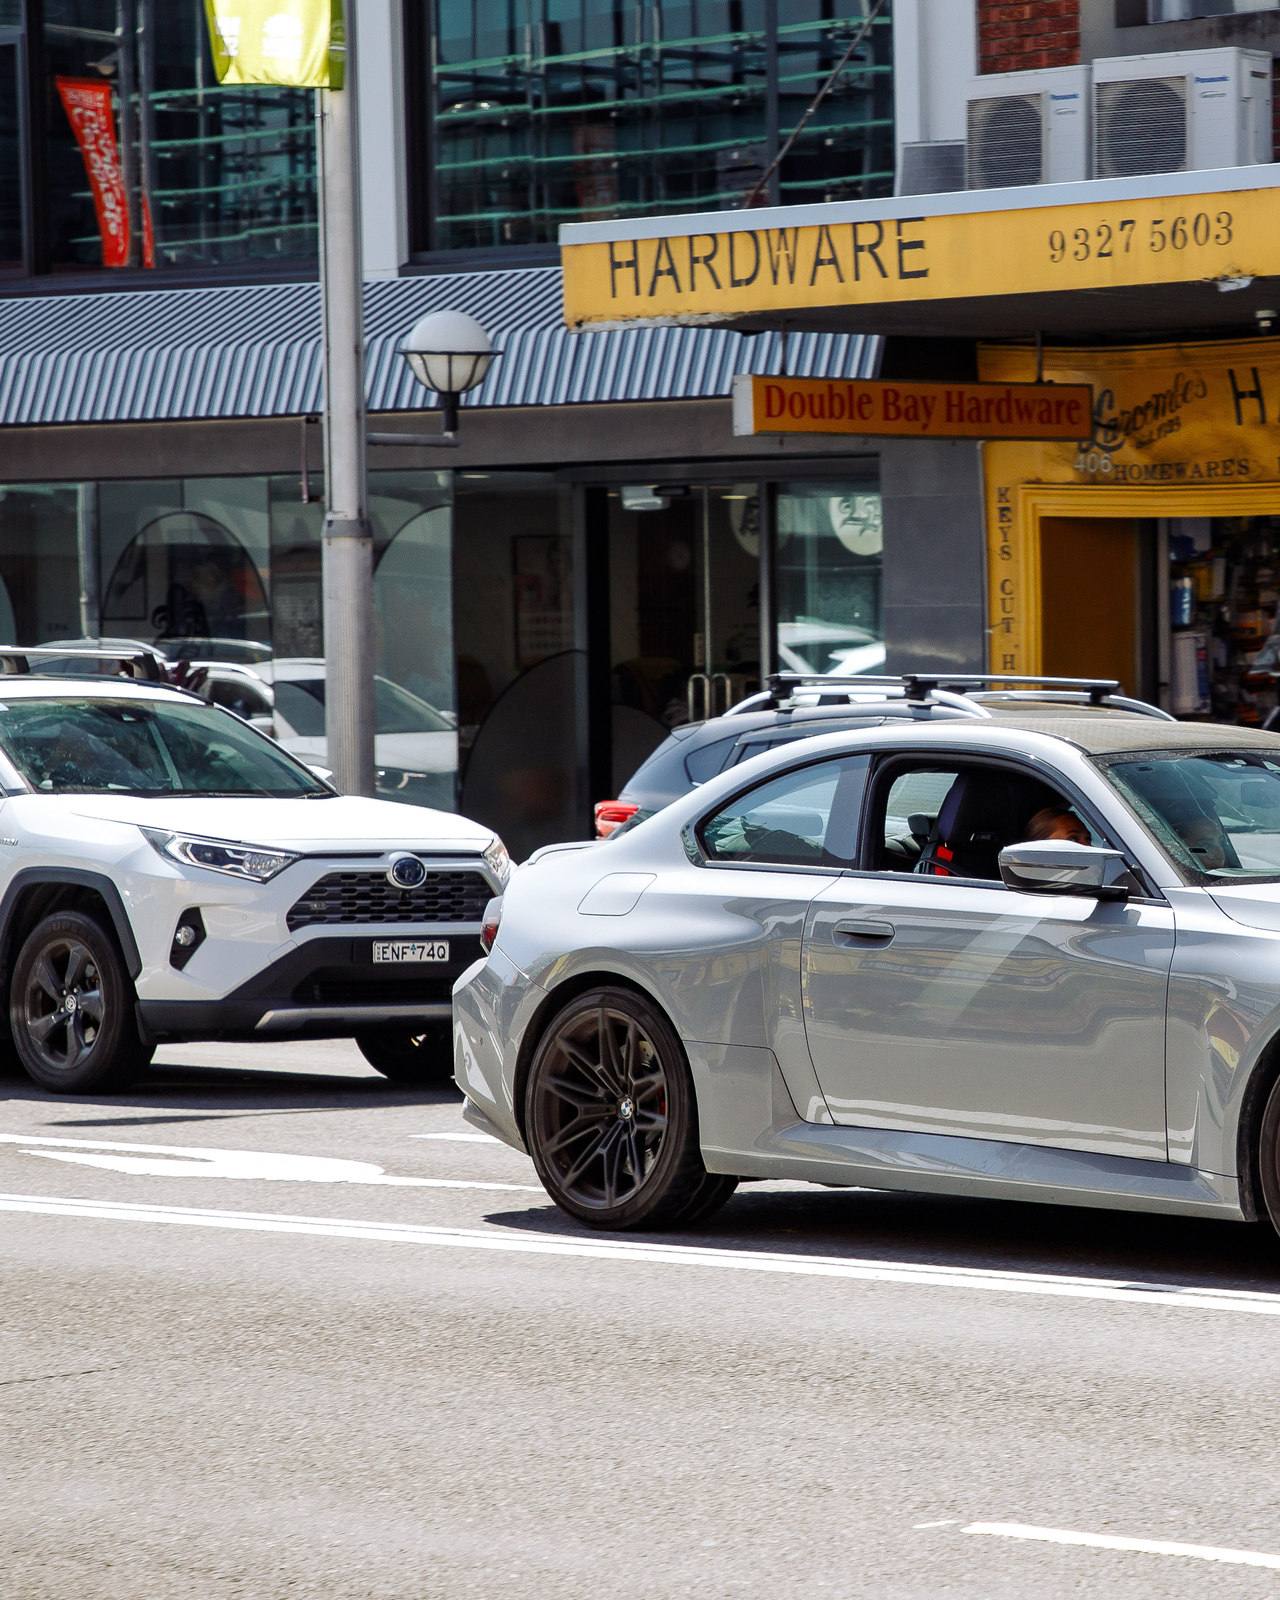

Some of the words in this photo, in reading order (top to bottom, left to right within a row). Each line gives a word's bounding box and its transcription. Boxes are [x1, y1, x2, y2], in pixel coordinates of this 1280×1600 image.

[608, 217, 930, 298] HARDWARE
[1048, 218, 1137, 263] 9327
[1149, 211, 1234, 253] 5603
[764, 383, 873, 420] Double
[881, 387, 938, 431] Bay
[943, 388, 1083, 426] Hardware
[1073, 452, 1114, 474] 406
[1113, 457, 1250, 481] HOMEWARES
[996, 486, 1014, 561] KEYS
